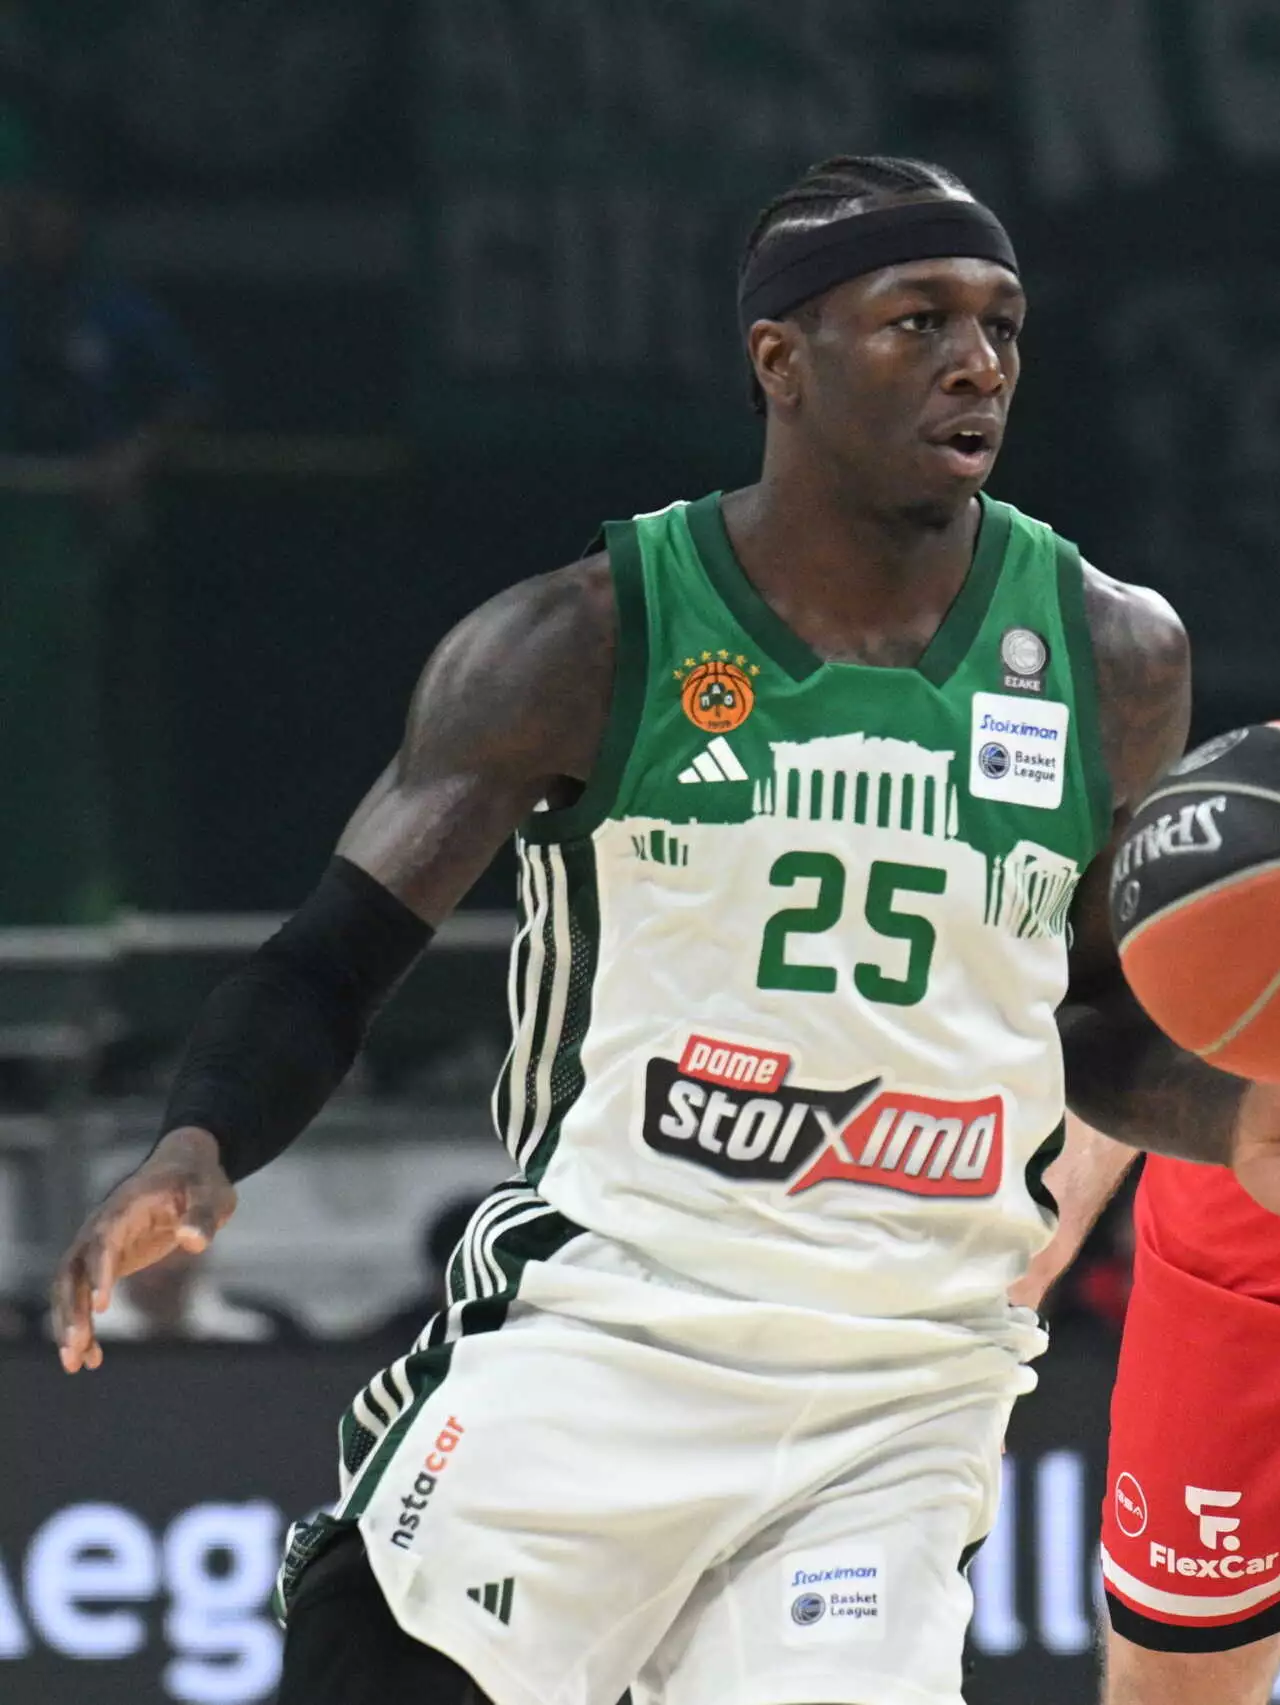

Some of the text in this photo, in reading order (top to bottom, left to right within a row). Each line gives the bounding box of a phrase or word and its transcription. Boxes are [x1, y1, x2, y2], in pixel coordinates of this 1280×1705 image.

[980, 714, 1058, 740] Stoiximan
[1015, 751, 1056, 769] Basket
[1014, 765, 1056, 783] League
[756, 850, 947, 1007] 25
[687, 1042, 780, 1084] pame
[1150, 1541, 1279, 1580] FlexCar
[791, 1566, 877, 1587] Stoiximan
[830, 1591, 877, 1605] Basket
[830, 1606, 878, 1619] League
